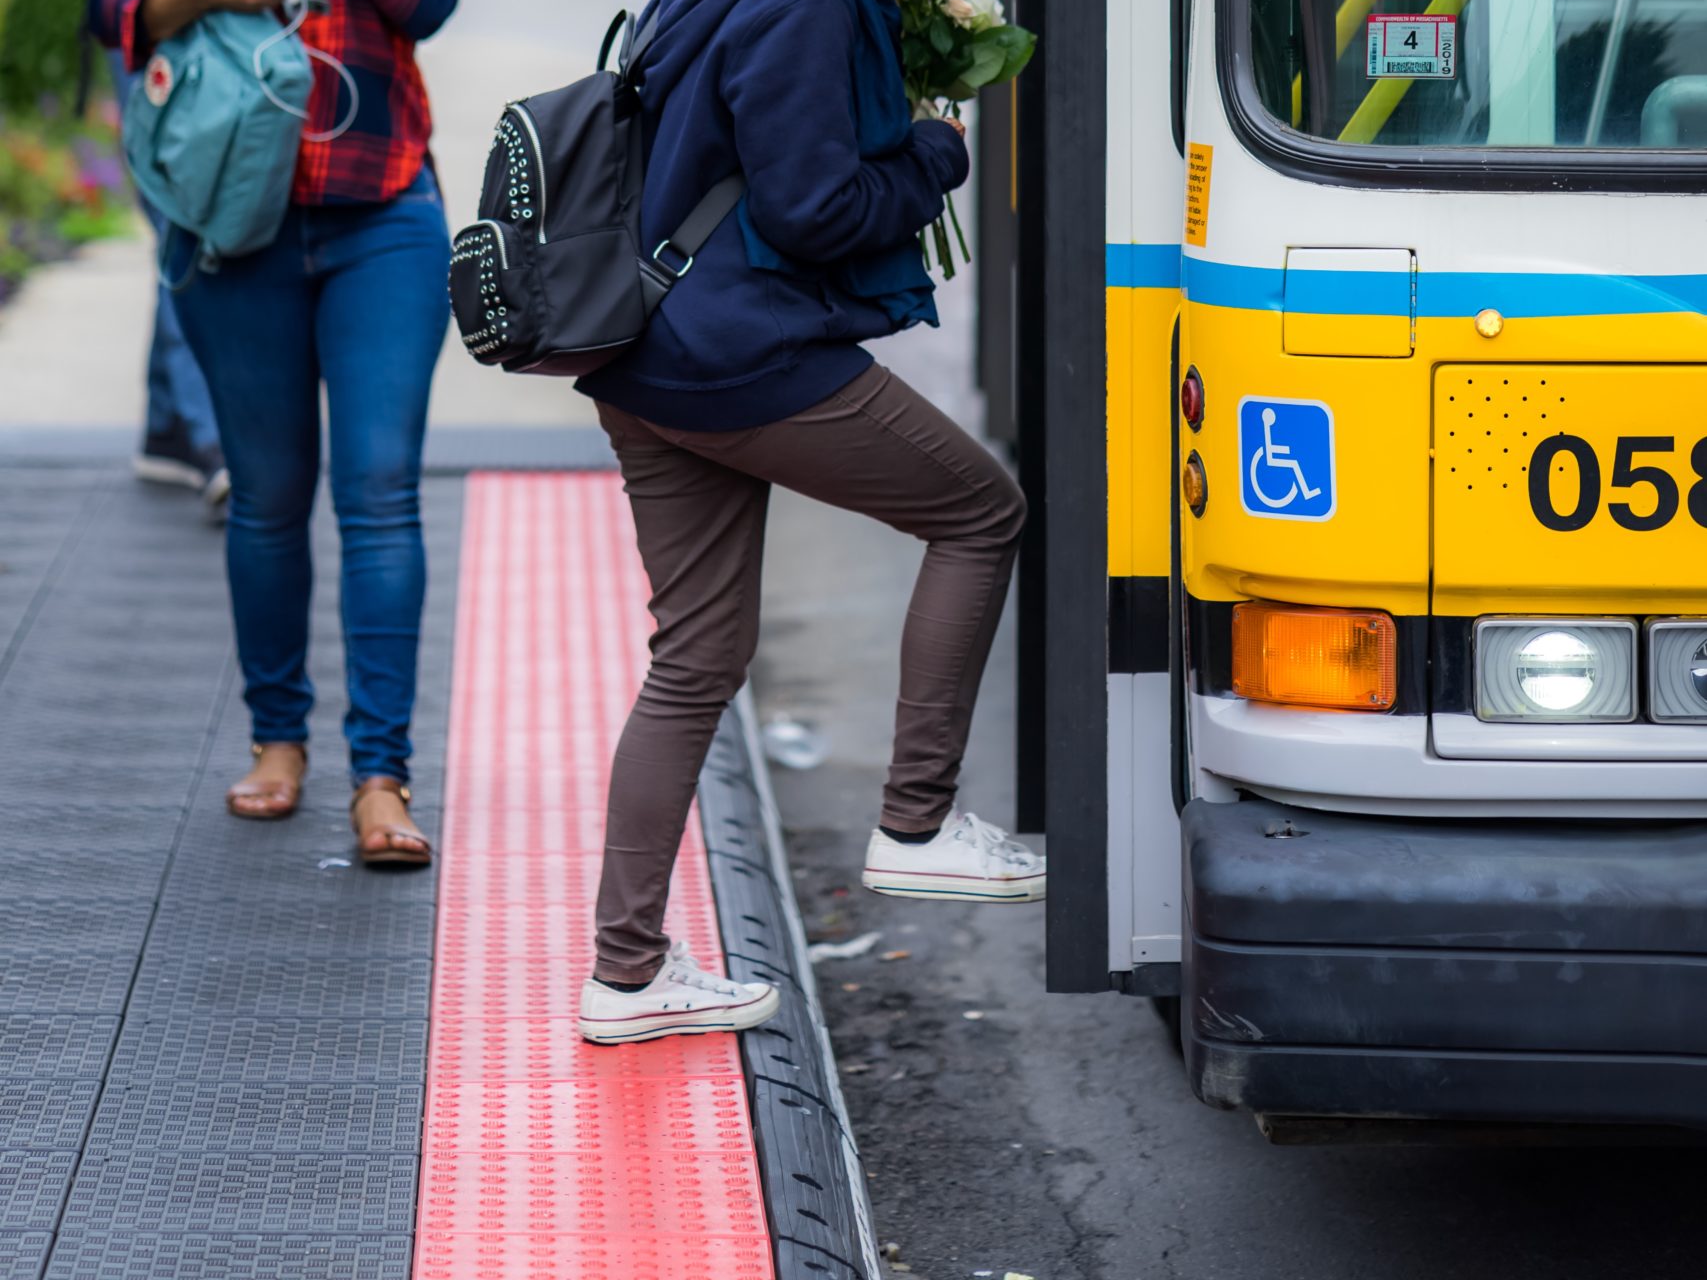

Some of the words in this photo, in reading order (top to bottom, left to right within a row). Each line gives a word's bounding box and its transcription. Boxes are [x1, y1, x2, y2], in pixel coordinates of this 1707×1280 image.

[1403, 30, 1418, 50] 4
[1441, 42, 1452, 75] 2019
[1528, 434, 1707, 532] 05
